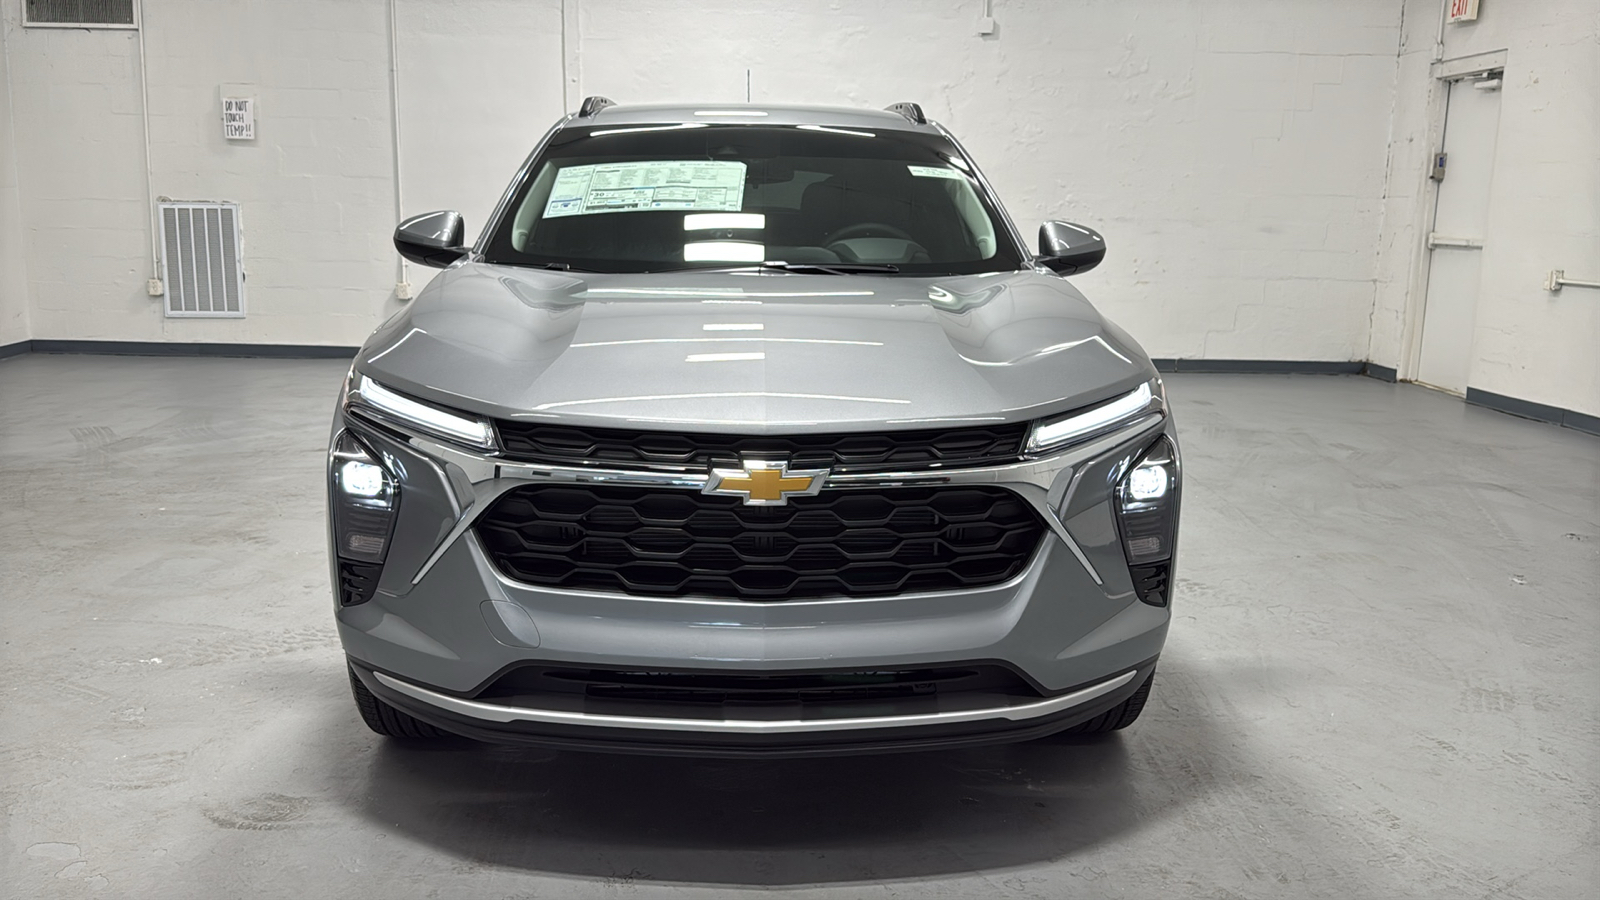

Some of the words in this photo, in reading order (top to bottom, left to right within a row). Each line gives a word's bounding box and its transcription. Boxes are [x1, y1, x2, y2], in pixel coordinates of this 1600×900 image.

[225, 100, 233, 112] DO
[235, 100, 249, 112] NOT
[225, 112, 244, 123] TOUCH
[226, 124, 251, 137] TEMP!!
